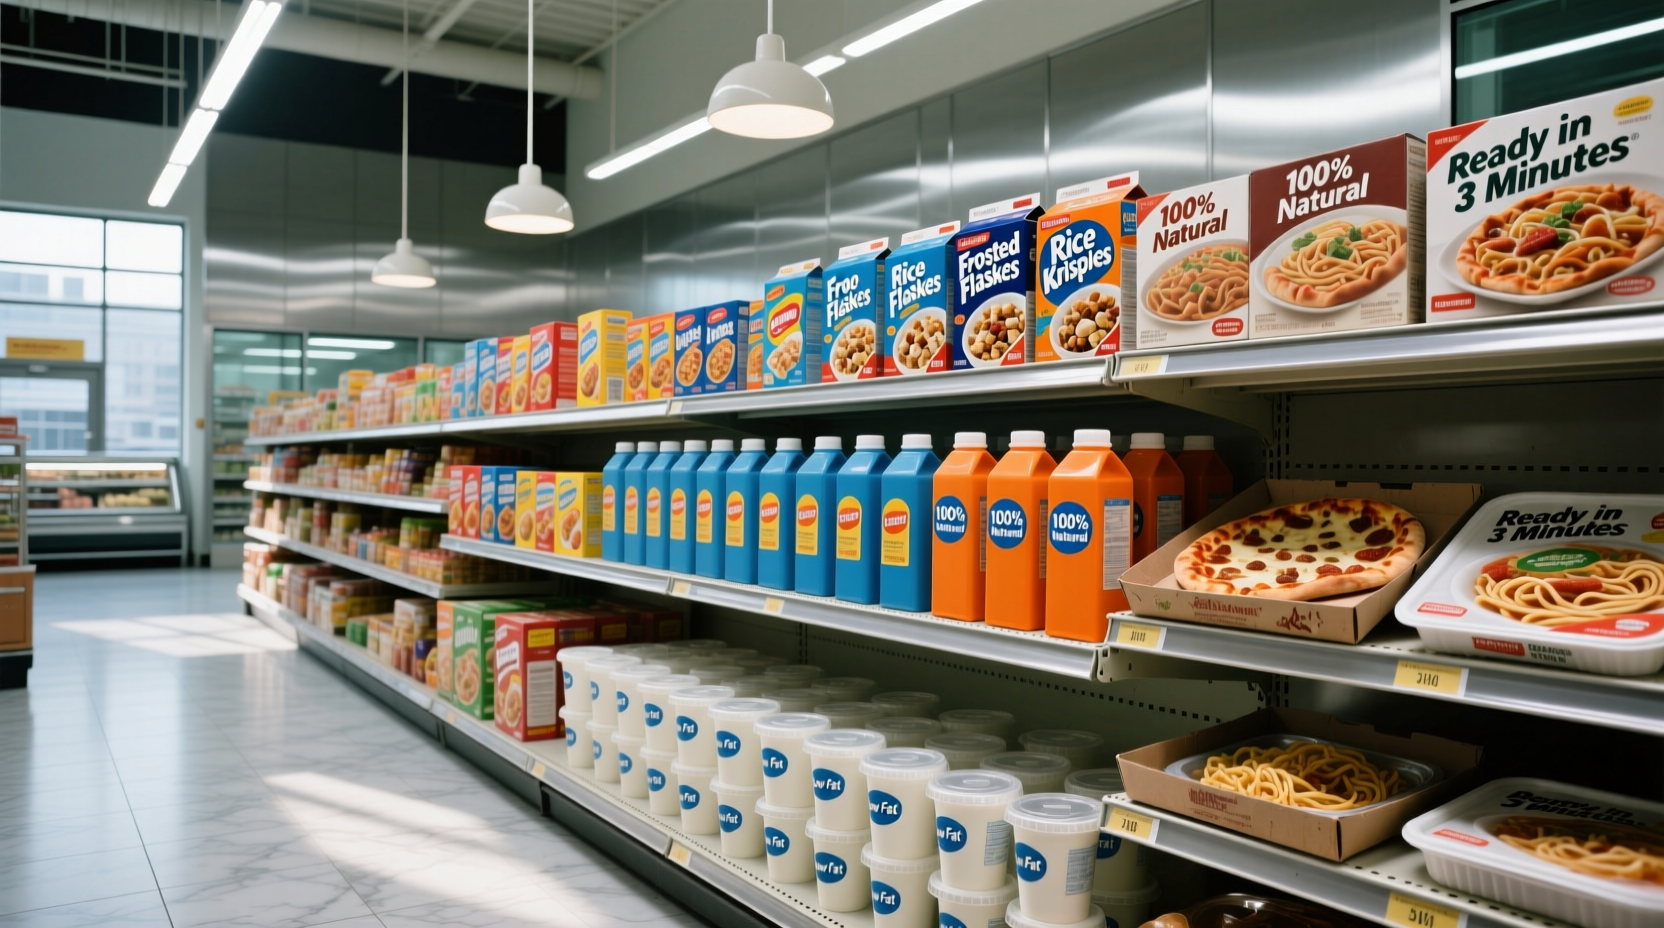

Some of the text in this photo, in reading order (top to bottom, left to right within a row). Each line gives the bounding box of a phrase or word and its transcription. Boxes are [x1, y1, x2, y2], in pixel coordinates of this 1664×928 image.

[1448, 113, 1591, 184] Ready in
[1286, 154, 1352, 195] 100%
[1455, 136, 1629, 213] 3 Minutes
[1160, 192, 1215, 227] 100%
[1277, 173, 1369, 224] Natural
[1050, 228, 1096, 265] Rice
[1152, 209, 1228, 253] Natural
[959, 230, 1020, 281] Frosted
[827, 274, 859, 302] Froo
[892, 261, 925, 289] Rice
[960, 260, 1020, 305] Flaskes
[936, 505, 965, 521] 100%
[991, 510, 1023, 525] 100%
[1053, 513, 1089, 530] 100%
[1496, 504, 1623, 526] Ready in
[1487, 521, 1629, 542] 3 Minutes
